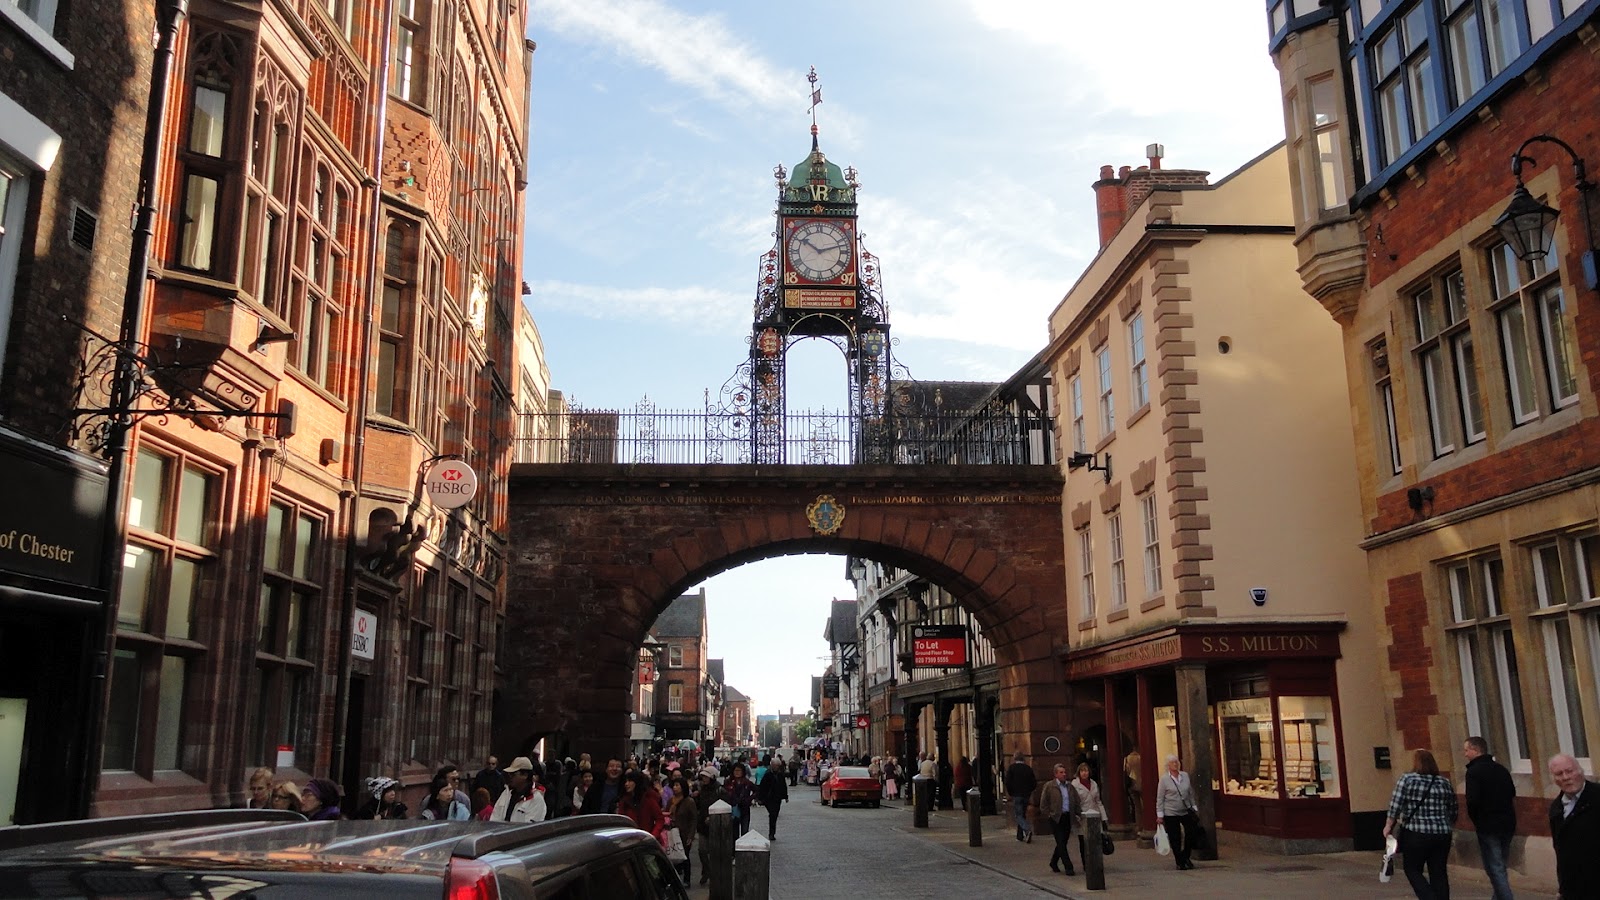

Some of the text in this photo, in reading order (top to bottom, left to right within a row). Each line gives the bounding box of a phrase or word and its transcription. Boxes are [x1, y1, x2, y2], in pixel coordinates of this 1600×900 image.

[810, 185, 829, 201] VR
[785, 271, 854, 285] 18 97
[431, 481, 471, 495] HSBC
[0, 530, 75, 564] of Chester
[352, 633, 369, 653] HSBC
[914, 641, 938, 649] To Let
[1201, 634, 1318, 653] S.S. MILTON
